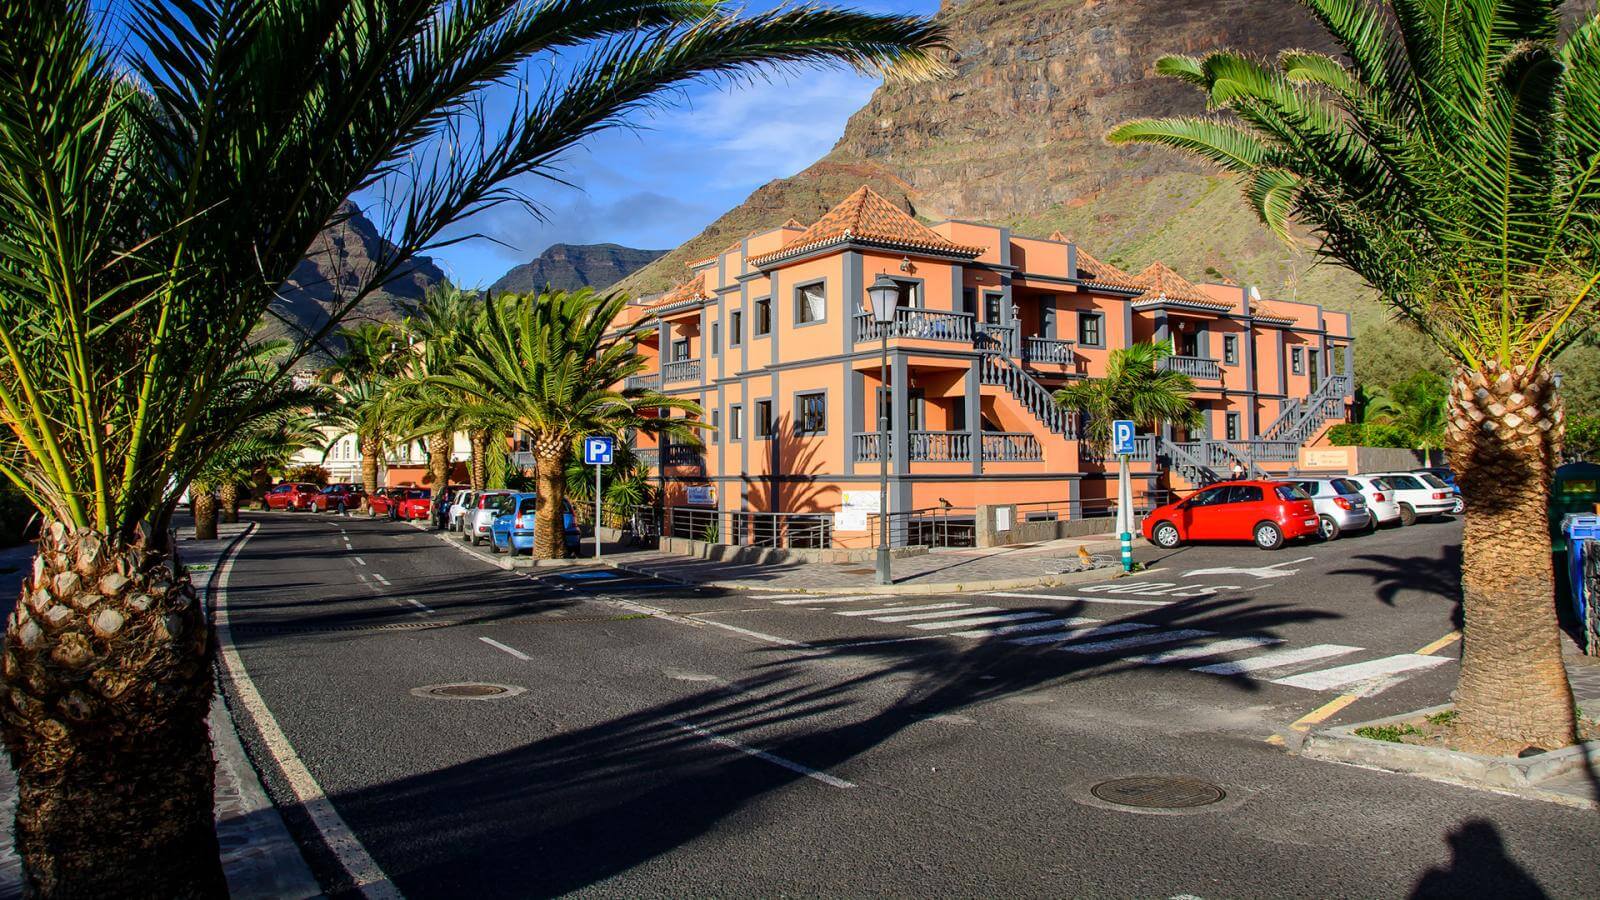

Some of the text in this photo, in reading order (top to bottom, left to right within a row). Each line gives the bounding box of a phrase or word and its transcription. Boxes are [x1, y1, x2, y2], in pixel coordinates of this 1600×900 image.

[1118, 424, 1130, 450] P
[590, 440, 606, 461] P
[1078, 582, 1241, 597] STOP
